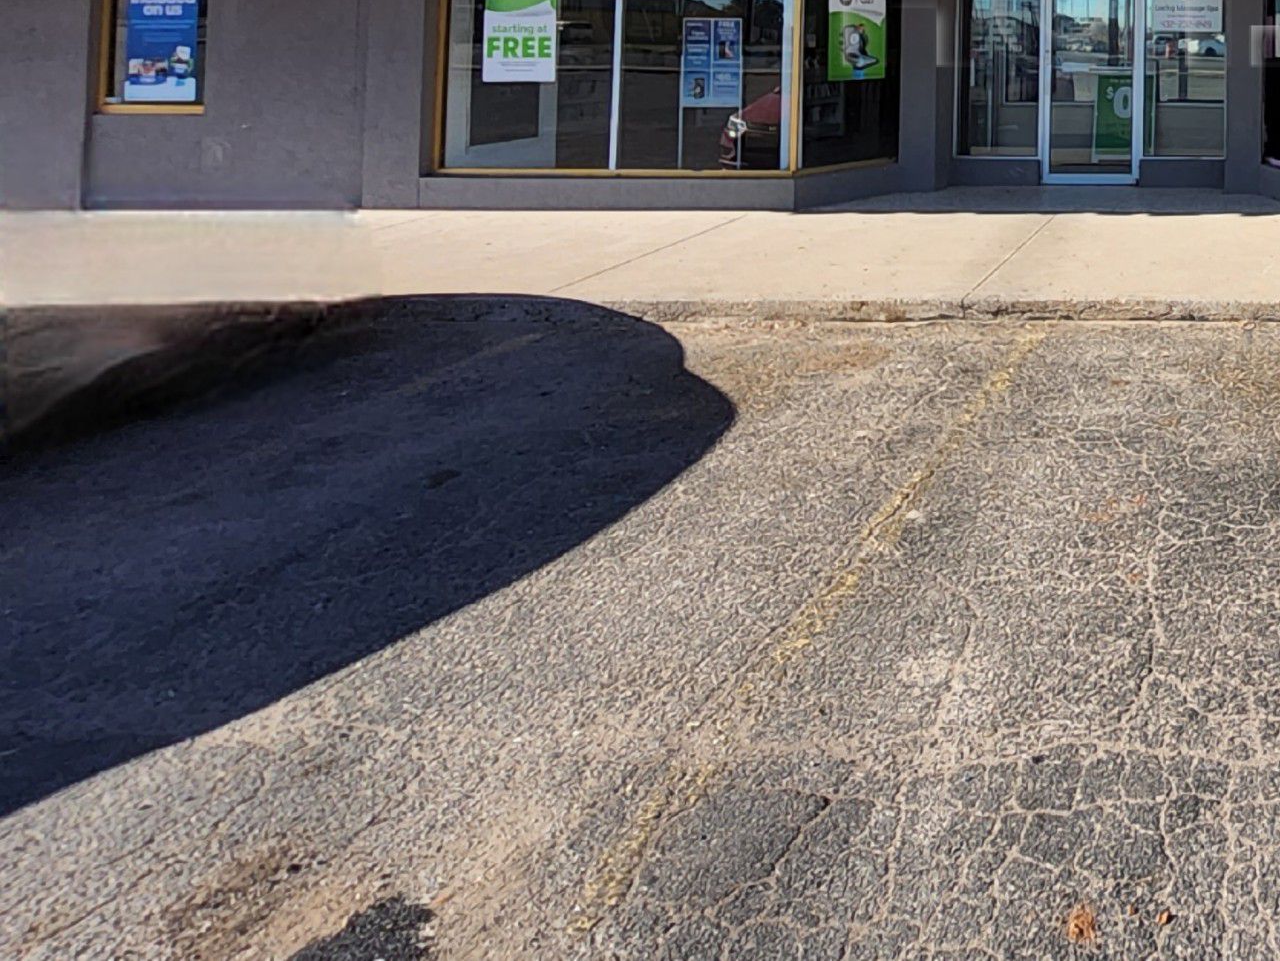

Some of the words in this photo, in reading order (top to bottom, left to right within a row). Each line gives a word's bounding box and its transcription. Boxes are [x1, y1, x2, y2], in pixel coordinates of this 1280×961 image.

[143, 4, 163, 16] on
[165, 4, 183, 16] us
[492, 22, 534, 34] starting
[537, 23, 548, 34] at
[487, 36, 552, 58] FREE
